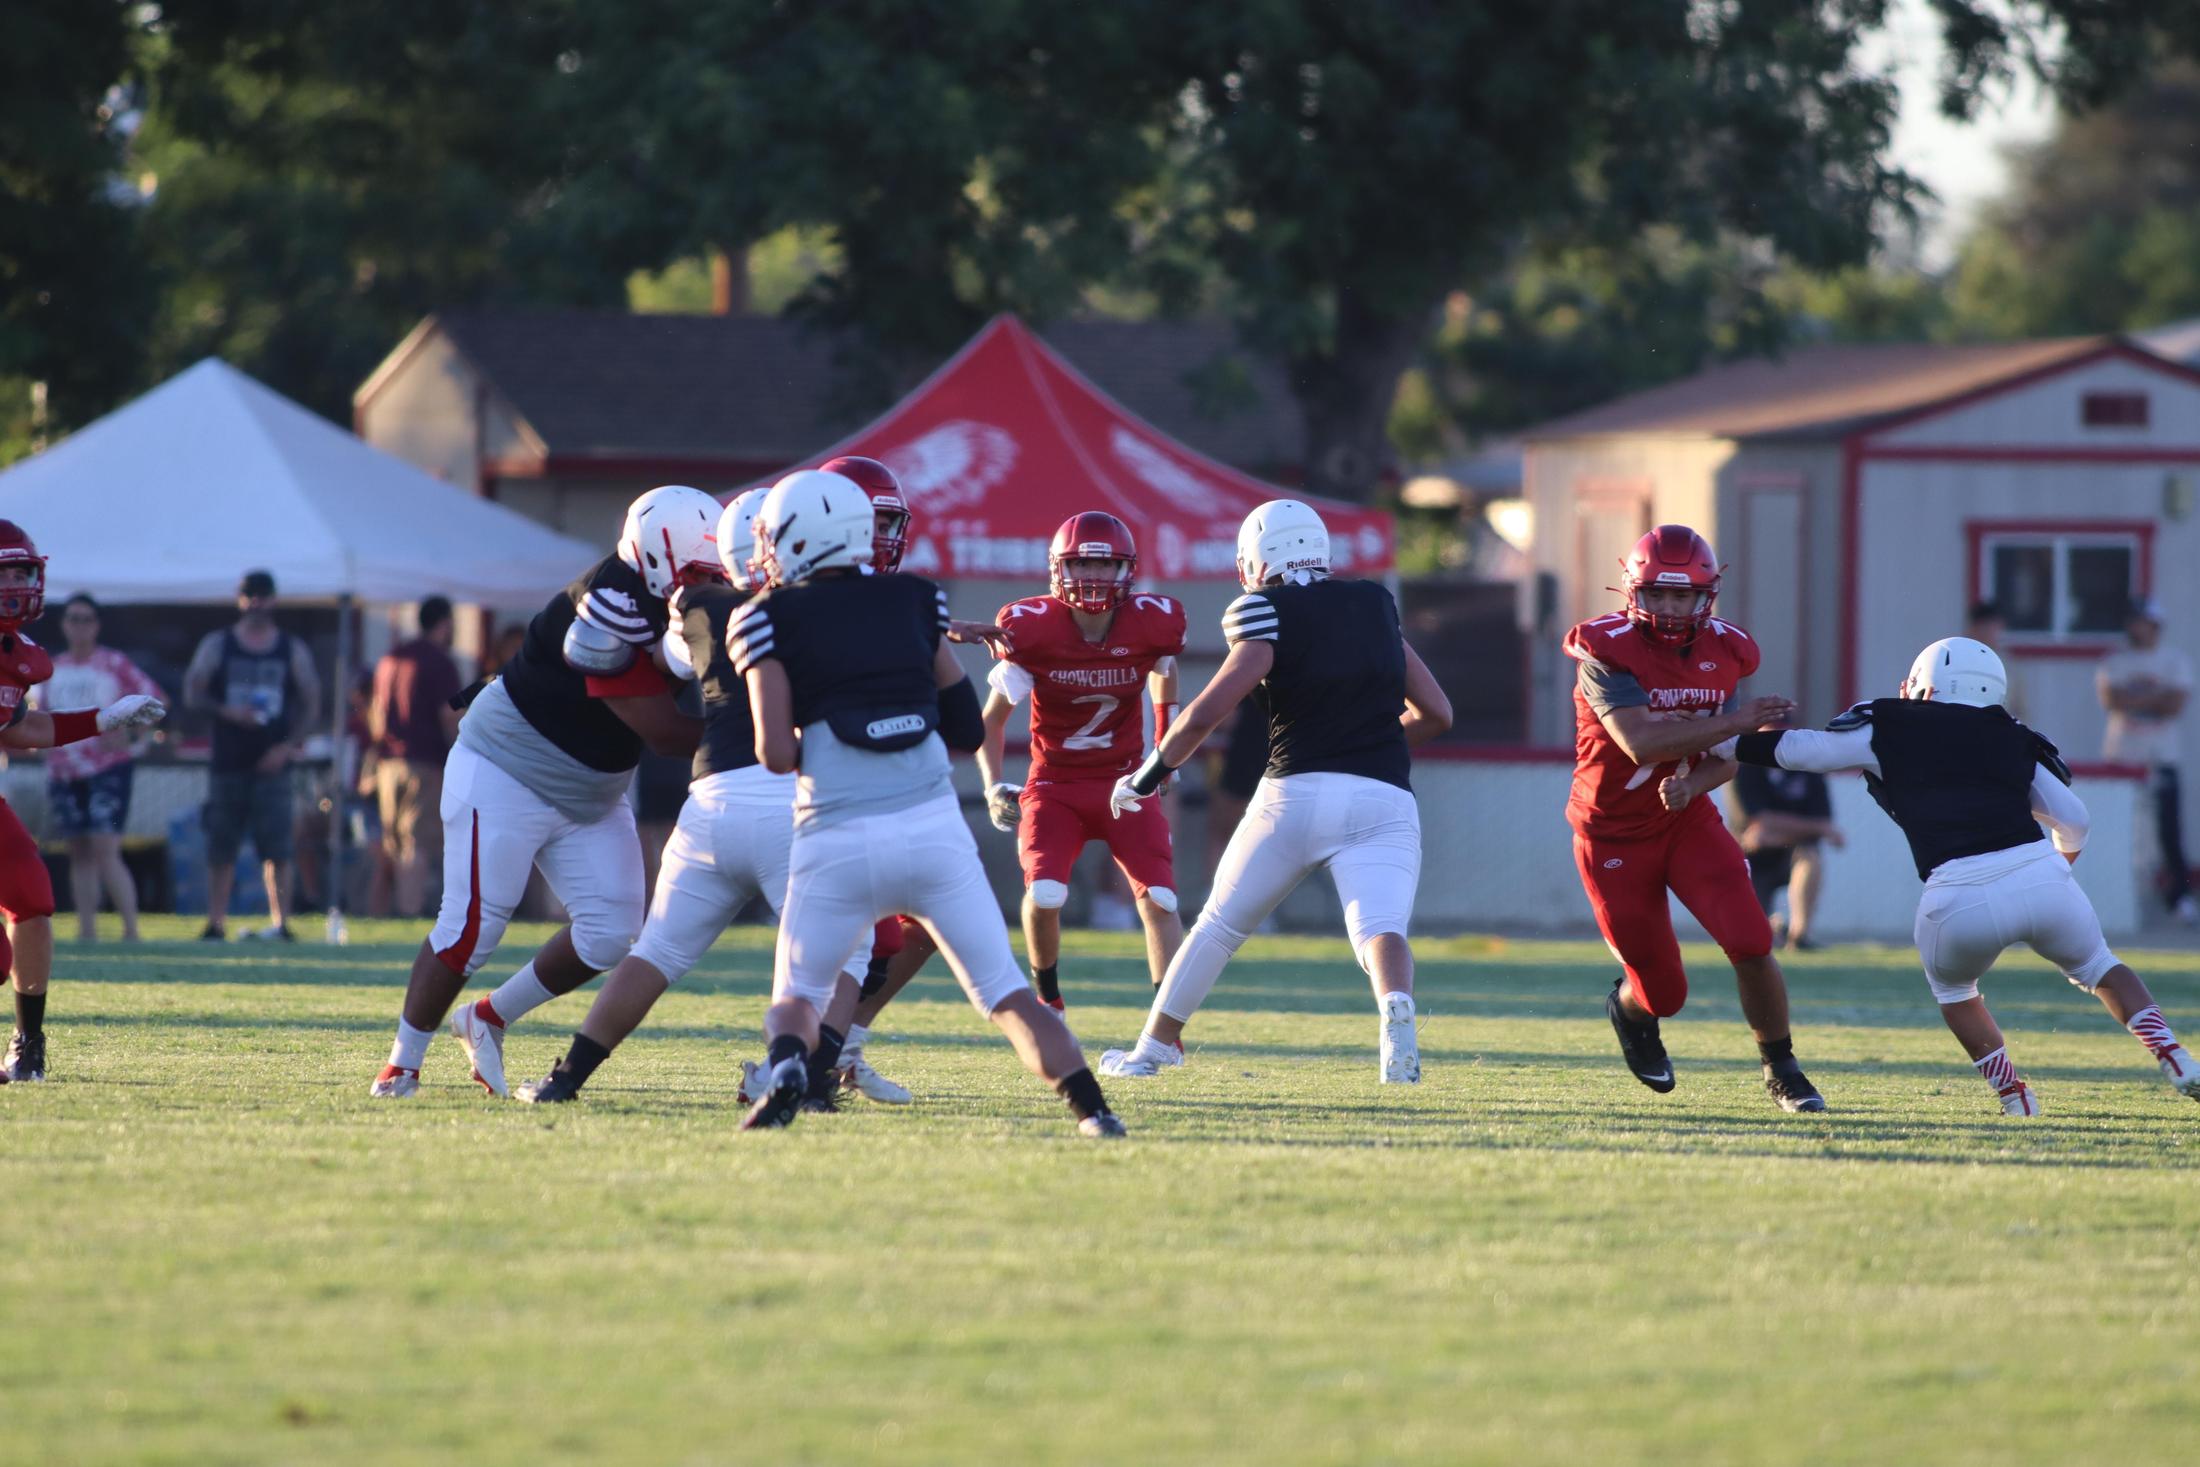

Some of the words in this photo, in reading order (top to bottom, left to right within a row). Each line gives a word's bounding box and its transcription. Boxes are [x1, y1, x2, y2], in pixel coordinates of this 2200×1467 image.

[1287, 558, 1322, 570] Riddell
[1012, 601, 1048, 618] 2
[1135, 597, 1172, 615] 2
[1050, 666, 1138, 687] CHOWCHILLA
[1062, 694, 1120, 750] 2
